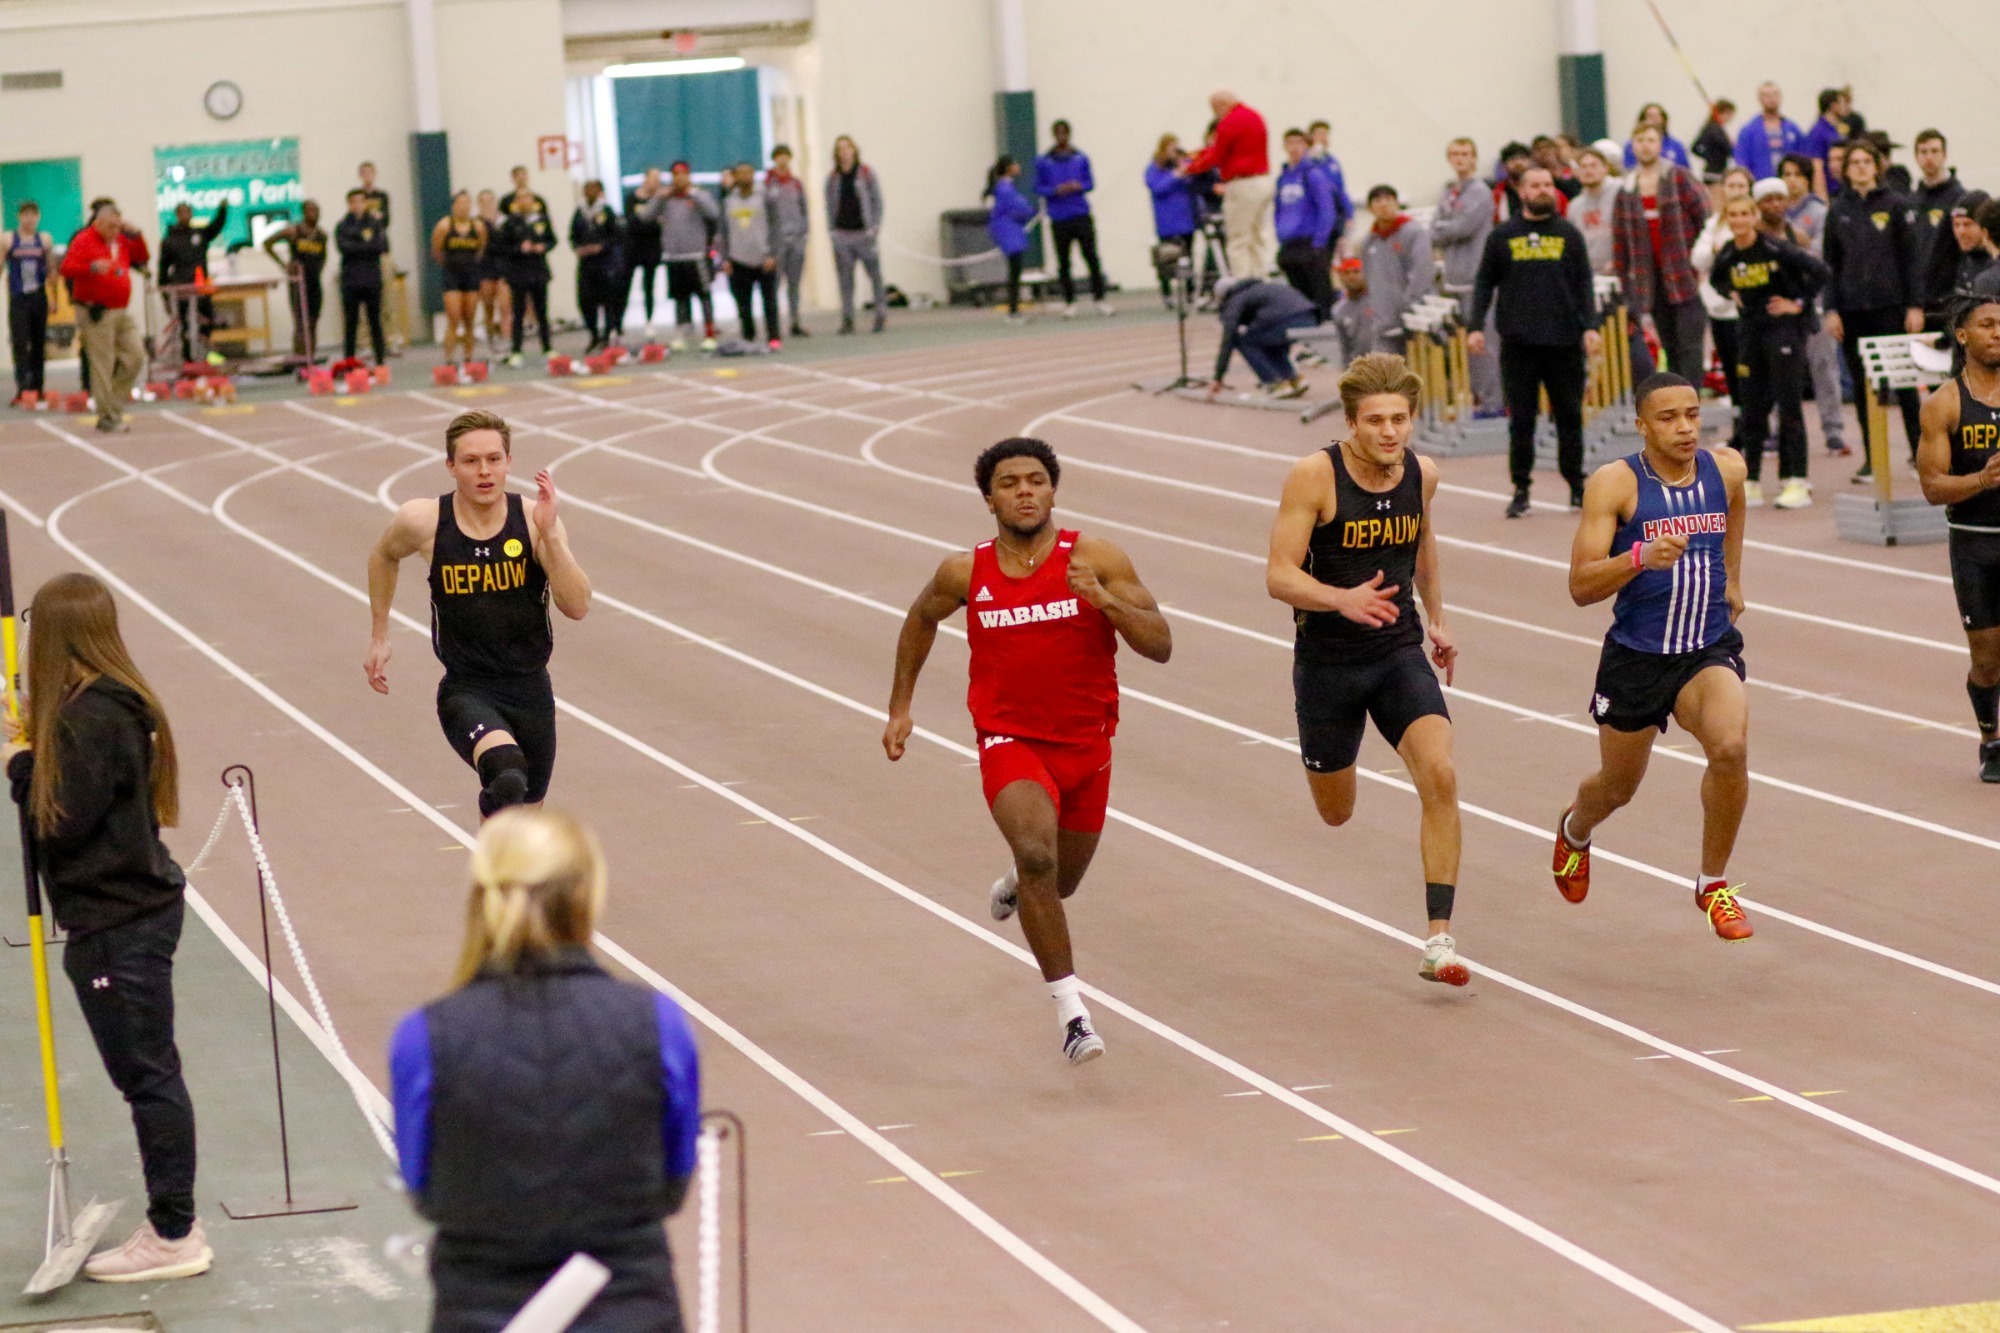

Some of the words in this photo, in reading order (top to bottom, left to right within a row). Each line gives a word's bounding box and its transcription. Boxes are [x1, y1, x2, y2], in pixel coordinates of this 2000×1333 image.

[1962, 423, 2000, 449] DEP
[1342, 513, 1420, 549] DEPAUW
[1643, 512, 1727, 542] HANOVER
[441, 557, 527, 594] DEPAUW
[978, 598, 1079, 629] WABASH
